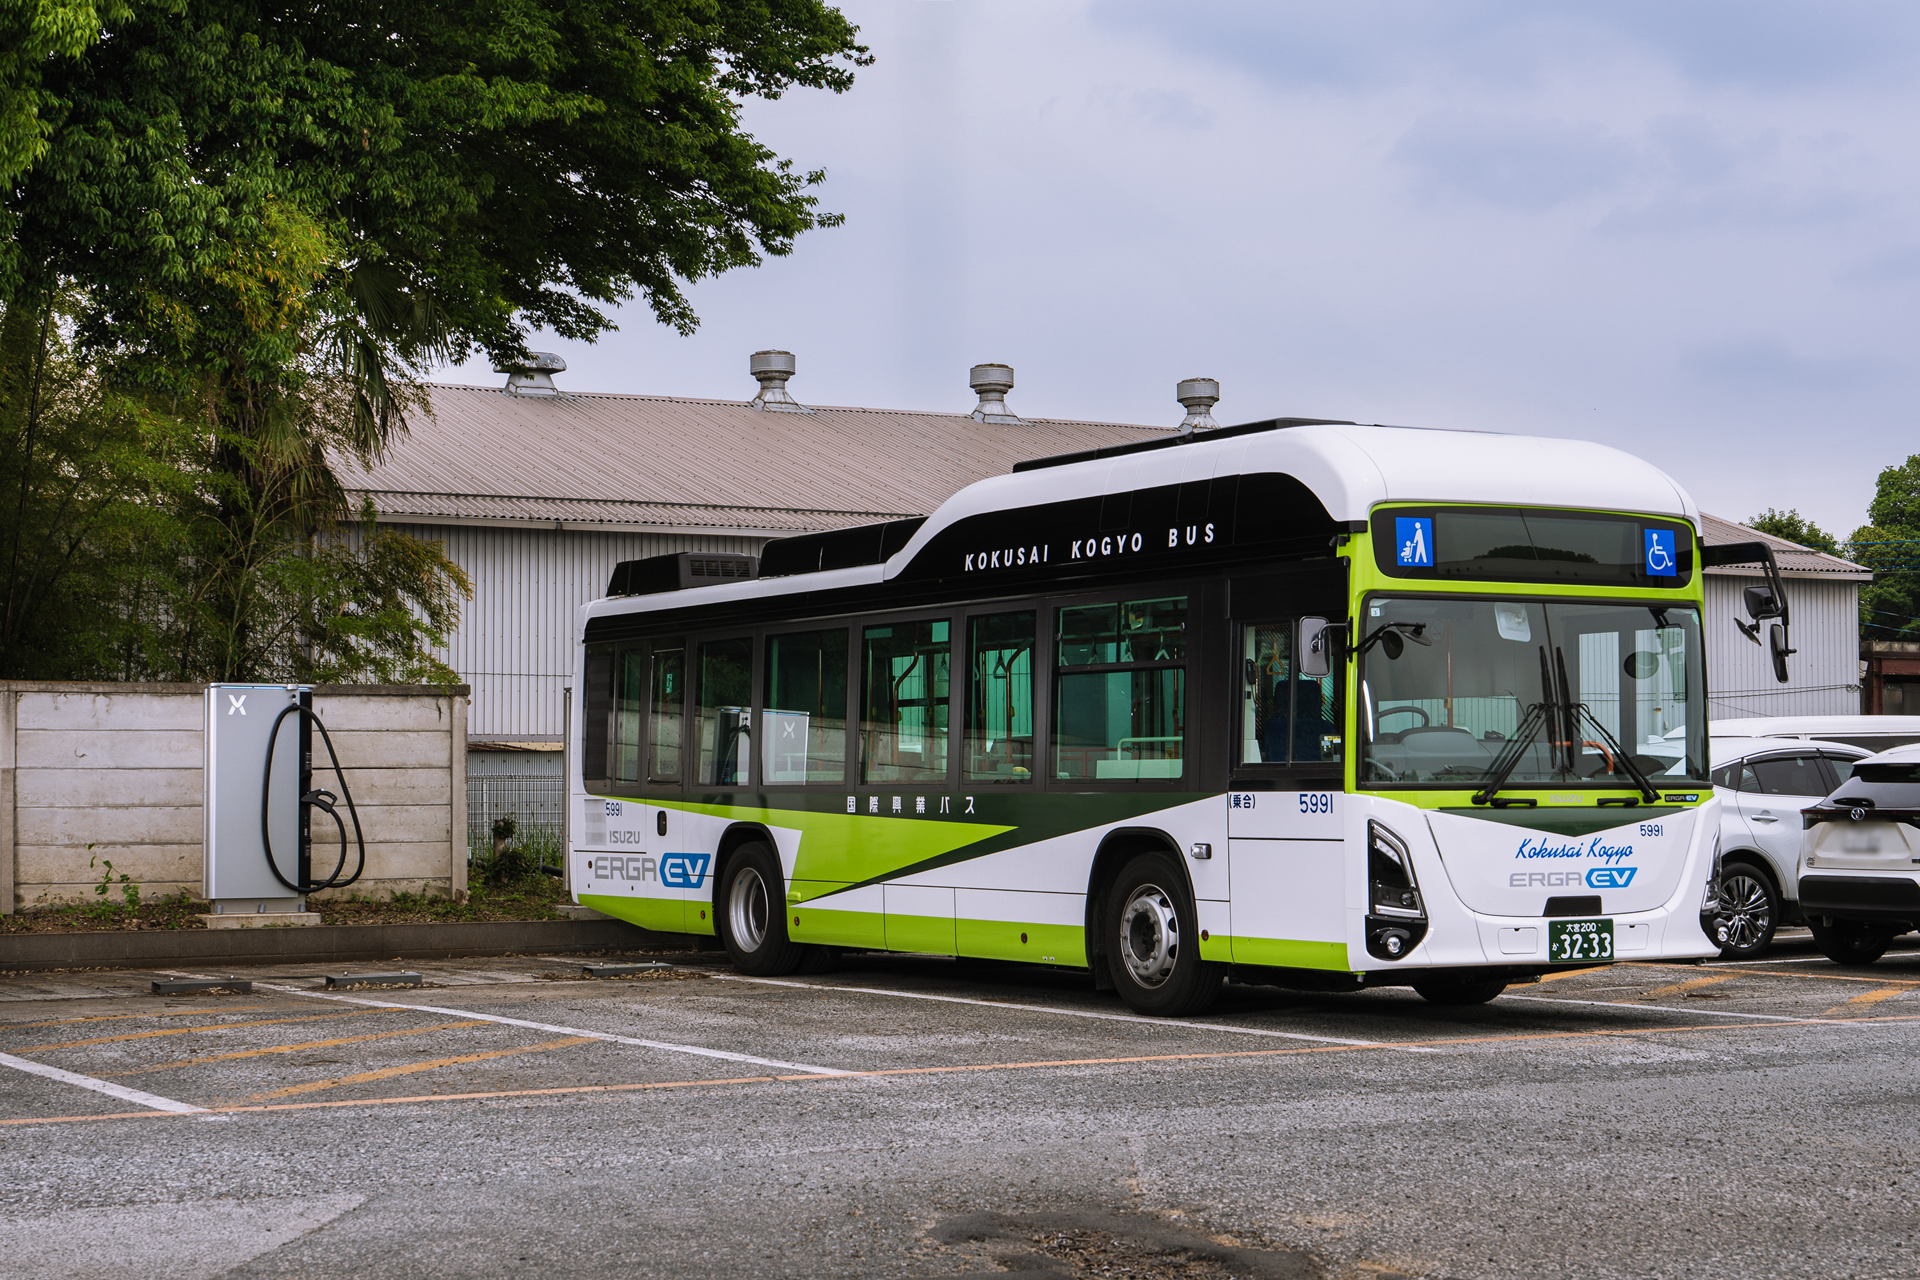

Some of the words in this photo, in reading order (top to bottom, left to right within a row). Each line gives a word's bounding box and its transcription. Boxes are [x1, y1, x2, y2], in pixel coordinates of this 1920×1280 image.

[964, 544, 1049, 572] KOKUSAI
[1071, 532, 1143, 559] KOGYO
[1168, 523, 1215, 548] BUS
[605, 802, 623, 817] 5991
[846, 795, 976, 814] 国際興業バス
[1229, 794, 1256, 809] (乗合)
[1299, 793, 1334, 814] 5991
[609, 830, 641, 844] ISUZU
[1640, 824, 1664, 837] 5991
[1515, 838, 1584, 859] Kokusai
[1586, 837, 1633, 865] Kogyo
[594, 856, 657, 882] ERGA
[663, 857, 705, 884] EV
[1509, 871, 1582, 888] ERGA
[1590, 870, 1632, 886] EV
